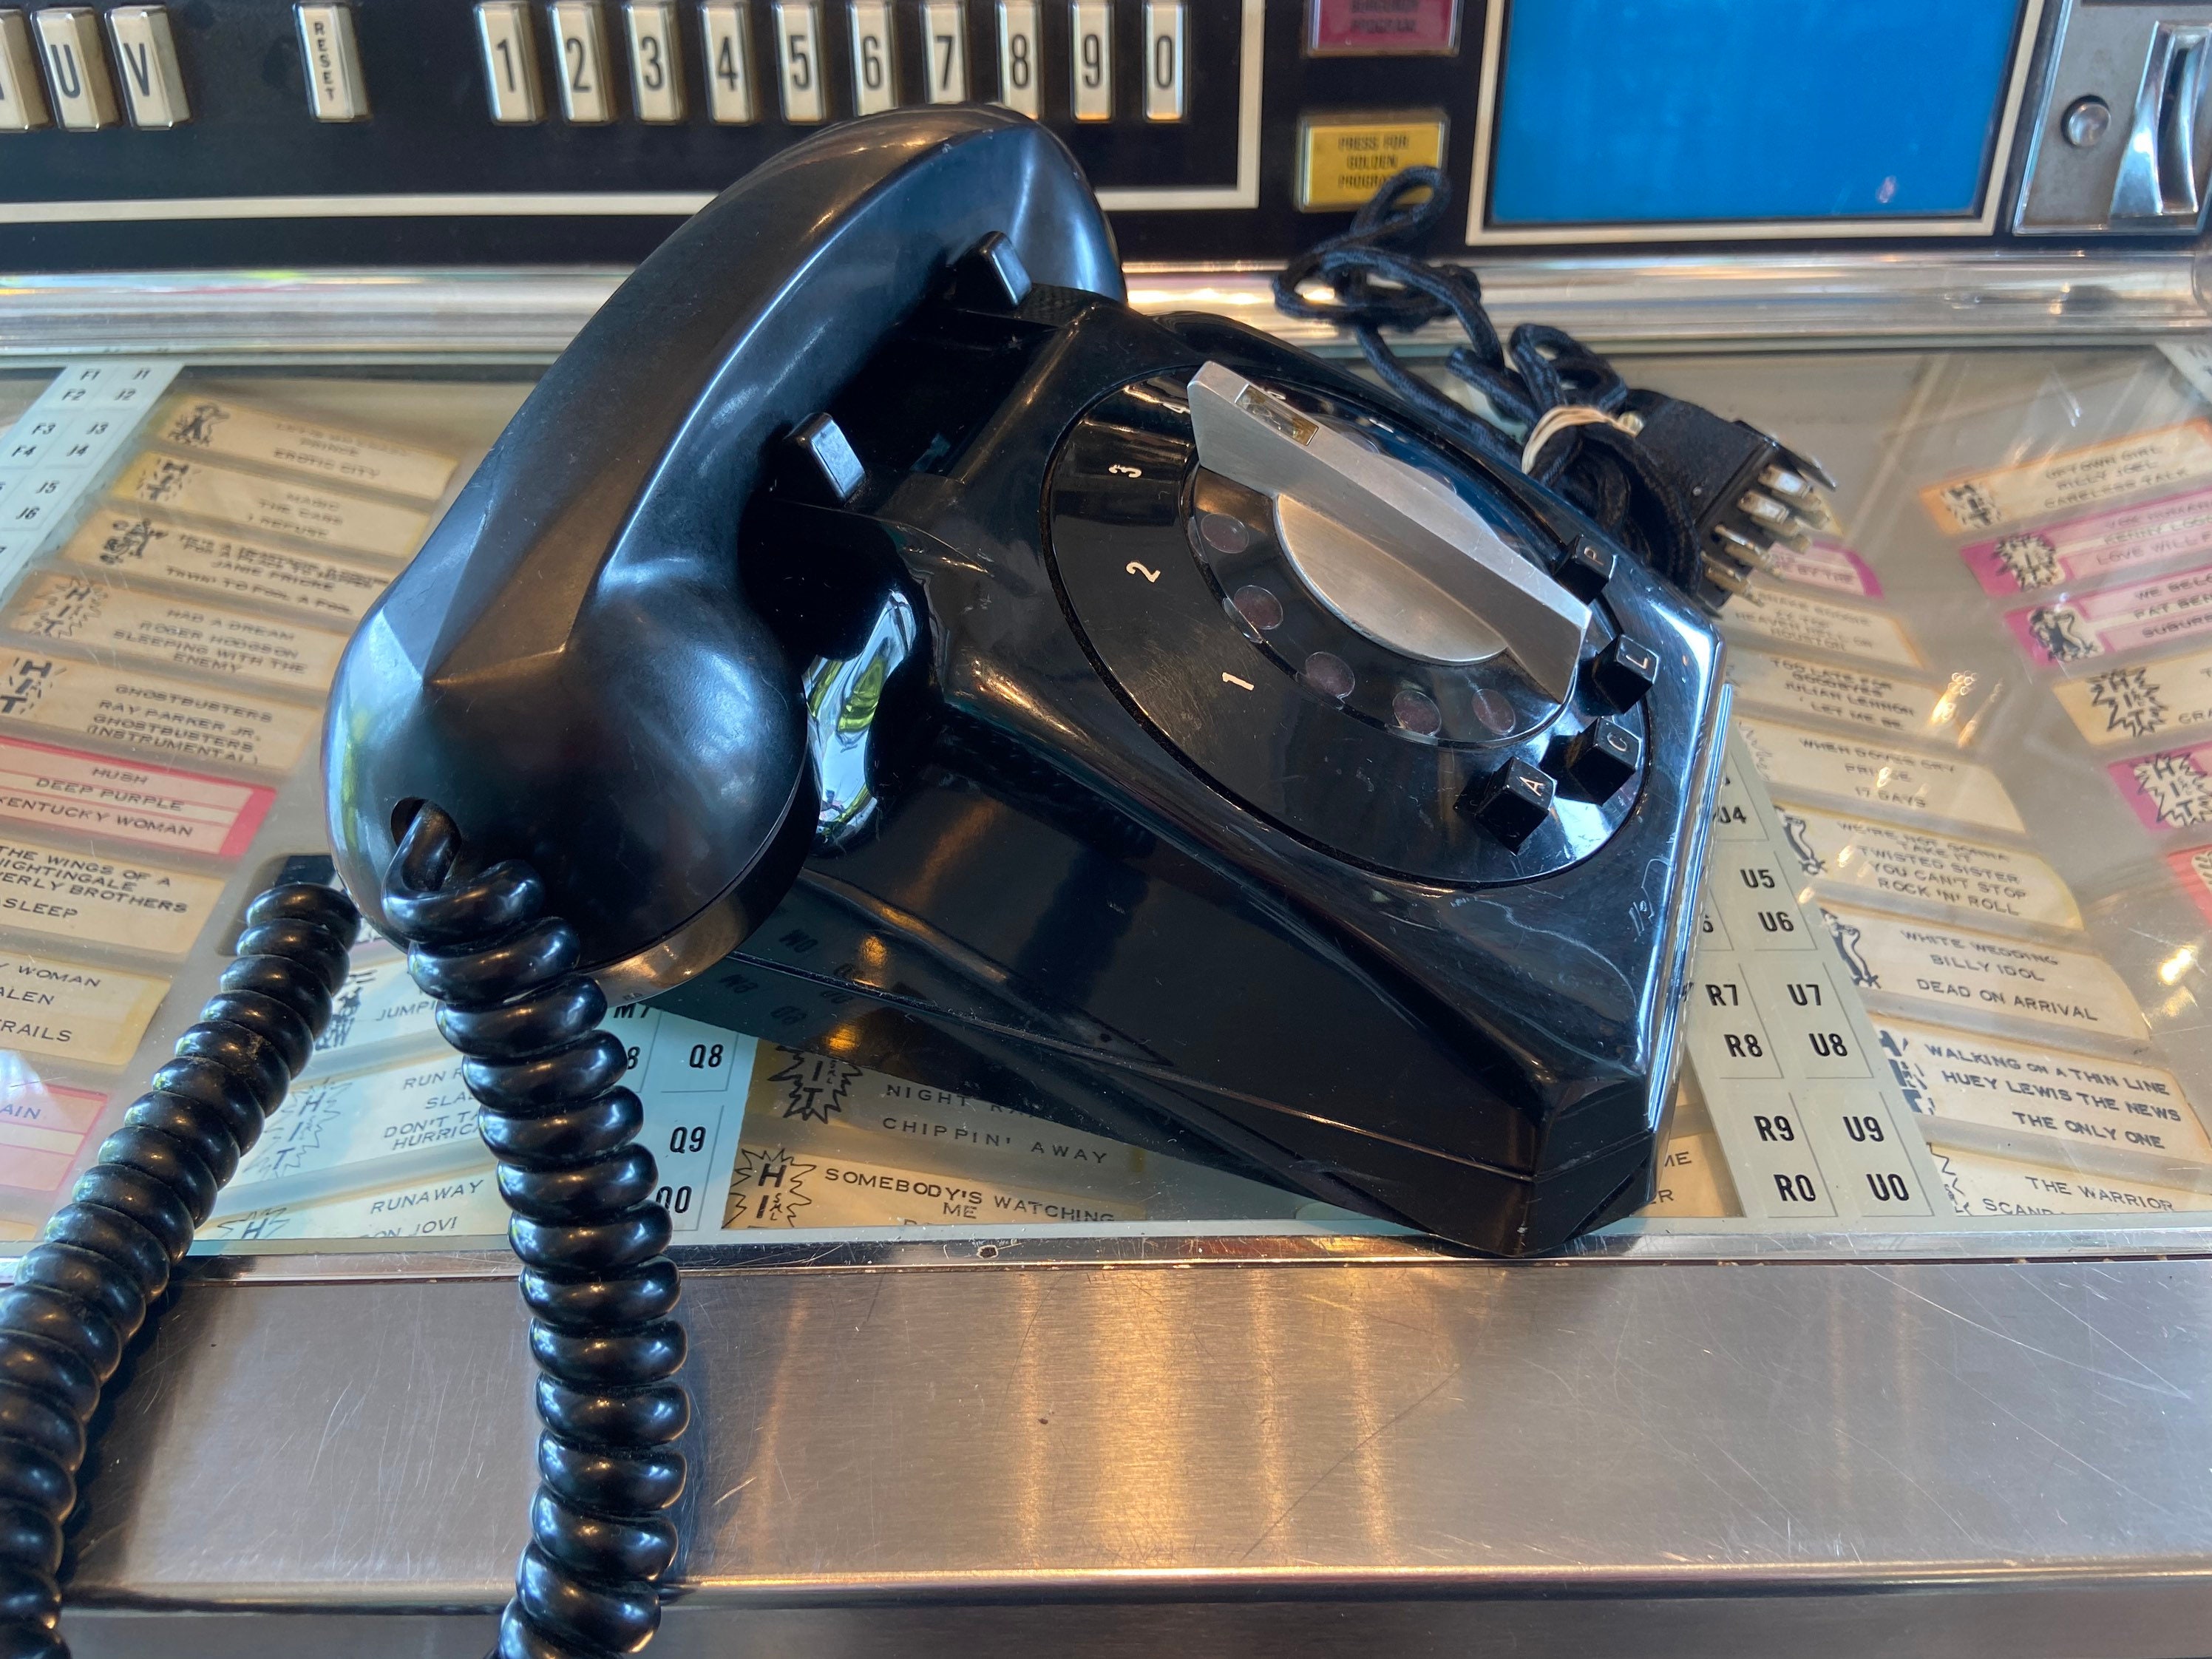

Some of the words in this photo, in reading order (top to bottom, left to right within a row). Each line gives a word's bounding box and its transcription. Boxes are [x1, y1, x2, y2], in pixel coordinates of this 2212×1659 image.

[50, 44, 81, 98] U
[123, 43, 150, 97] V
[313, 21, 336, 101] RESET
[496, 38, 516, 92] 1
[566, 37, 590, 93] 2
[642, 36, 662, 89] 3
[717, 36, 738, 91] 4
[790, 35, 810, 90] 5
[863, 35, 882, 89] 6
[937, 35, 954, 89] 7
[1012, 34, 1029, 87] 8
[1083, 34, 1100, 87] 9
[1338, 135, 1379, 151] PRESS
[1383, 134, 1409, 149] FOR
[81, 370, 101, 380] F1
[132, 370, 150, 379] J1
[62, 390, 86, 400] F2
[115, 390, 136, 400] J2
[32, 424, 56, 435] F3
[86, 423, 109, 434] J3
[12, 446, 37, 457] F4
[67, 445, 89, 456] J4
[1109, 463, 1143, 478] 3
[36, 481, 60, 493] J5
[16, 506, 39, 519] J6
[1584, 546, 1604, 566] P
[1126, 560, 1161, 583] 2
[173, 652, 242, 673] ENEMY
[1626, 655, 1648, 669] L
[1221, 671, 1255, 691] 1
[98, 699, 141, 714] RAY
[145, 708, 225, 731] PARKER
[115, 683, 273, 722] GHOSTBUSTERS
[93, 713, 254, 753] GHOSTBUSTERS
[1607, 732, 1626, 752] C
[92, 767, 149, 785] HUSH
[1519, 776, 1545, 797] A
[36, 777, 93, 795] DEEP
[100, 788, 185, 812] PURPLE
[117, 815, 194, 837] WOMAN
[47, 855, 114, 875] WINGS
[123, 869, 152, 881] OF
[157, 878, 171, 887] A
[1741, 869, 1774, 888] U5
[1872, 861, 1907, 878] YOU
[1914, 869, 1968, 889] CAN'T
[1978, 881, 2027, 900] STOP
[1951, 861, 2021, 884] SISTER
[69, 884, 188, 913] BROTHERS
[1878, 878, 1930, 898] ROCK
[1969, 895, 2020, 916] ROLL
[1758, 912, 1794, 932] U6
[1901, 930, 1964, 949] WHITE
[1972, 942, 2058, 965] WEDDING
[18, 966, 101, 988] WOMAN
[1930, 954, 1989, 973] BILLY
[1998, 965, 2045, 982] IDOL
[1706, 984, 1739, 1006] R7
[1787, 984, 1822, 1006] U7
[1916, 978, 1971, 998] DEAD
[1980, 988, 2006, 1004] ON
[2014, 996, 2098, 1021] ARRIVAL
[0, 1020, 72, 1042] RAILS
[689, 1044, 724, 1069] Q8
[1723, 1034, 1763, 1057] R8
[1808, 1034, 1848, 1056] U8
[403, 1073, 446, 1090] RUN
[1924, 1043, 2021, 1071] WALKING
[2028, 1062, 2048, 1073] ON
[2056, 1068, 2067, 1077] A
[2068, 1068, 2118, 1086] THIN
[2125, 1077, 2170, 1096] LINE
[886, 1084, 971, 1107] NIGHT
[1941, 1071, 1998, 1090] HUEY
[2006, 1080, 2072, 1101] LEWIS
[2077, 1092, 2119, 1111] THE
[2126, 1100, 2181, 1122] NEWS
[384, 1116, 449, 1139] DON'T
[670, 1126, 706, 1154] Q9
[1754, 1116, 1794, 1141] R9
[1842, 1116, 1884, 1141] U9
[2012, 1111, 2057, 1130] THE
[2065, 1119, 2117, 1141] ONLY
[2125, 1130, 2165, 1149] ONE
[883, 1117, 1011, 1147] CHIPPIN'
[1031, 1141, 1107, 1164] AWAY
[370, 1180, 484, 1214] RUNAWAY
[825, 1168, 983, 1204] SOMEBODY'S
[994, 1195, 1114, 1221] WATCHING
[2025, 1176, 2072, 1195] THE
[2080, 1184, 2174, 1211] WARRIOR
[943, 1202, 977, 1219] ME
